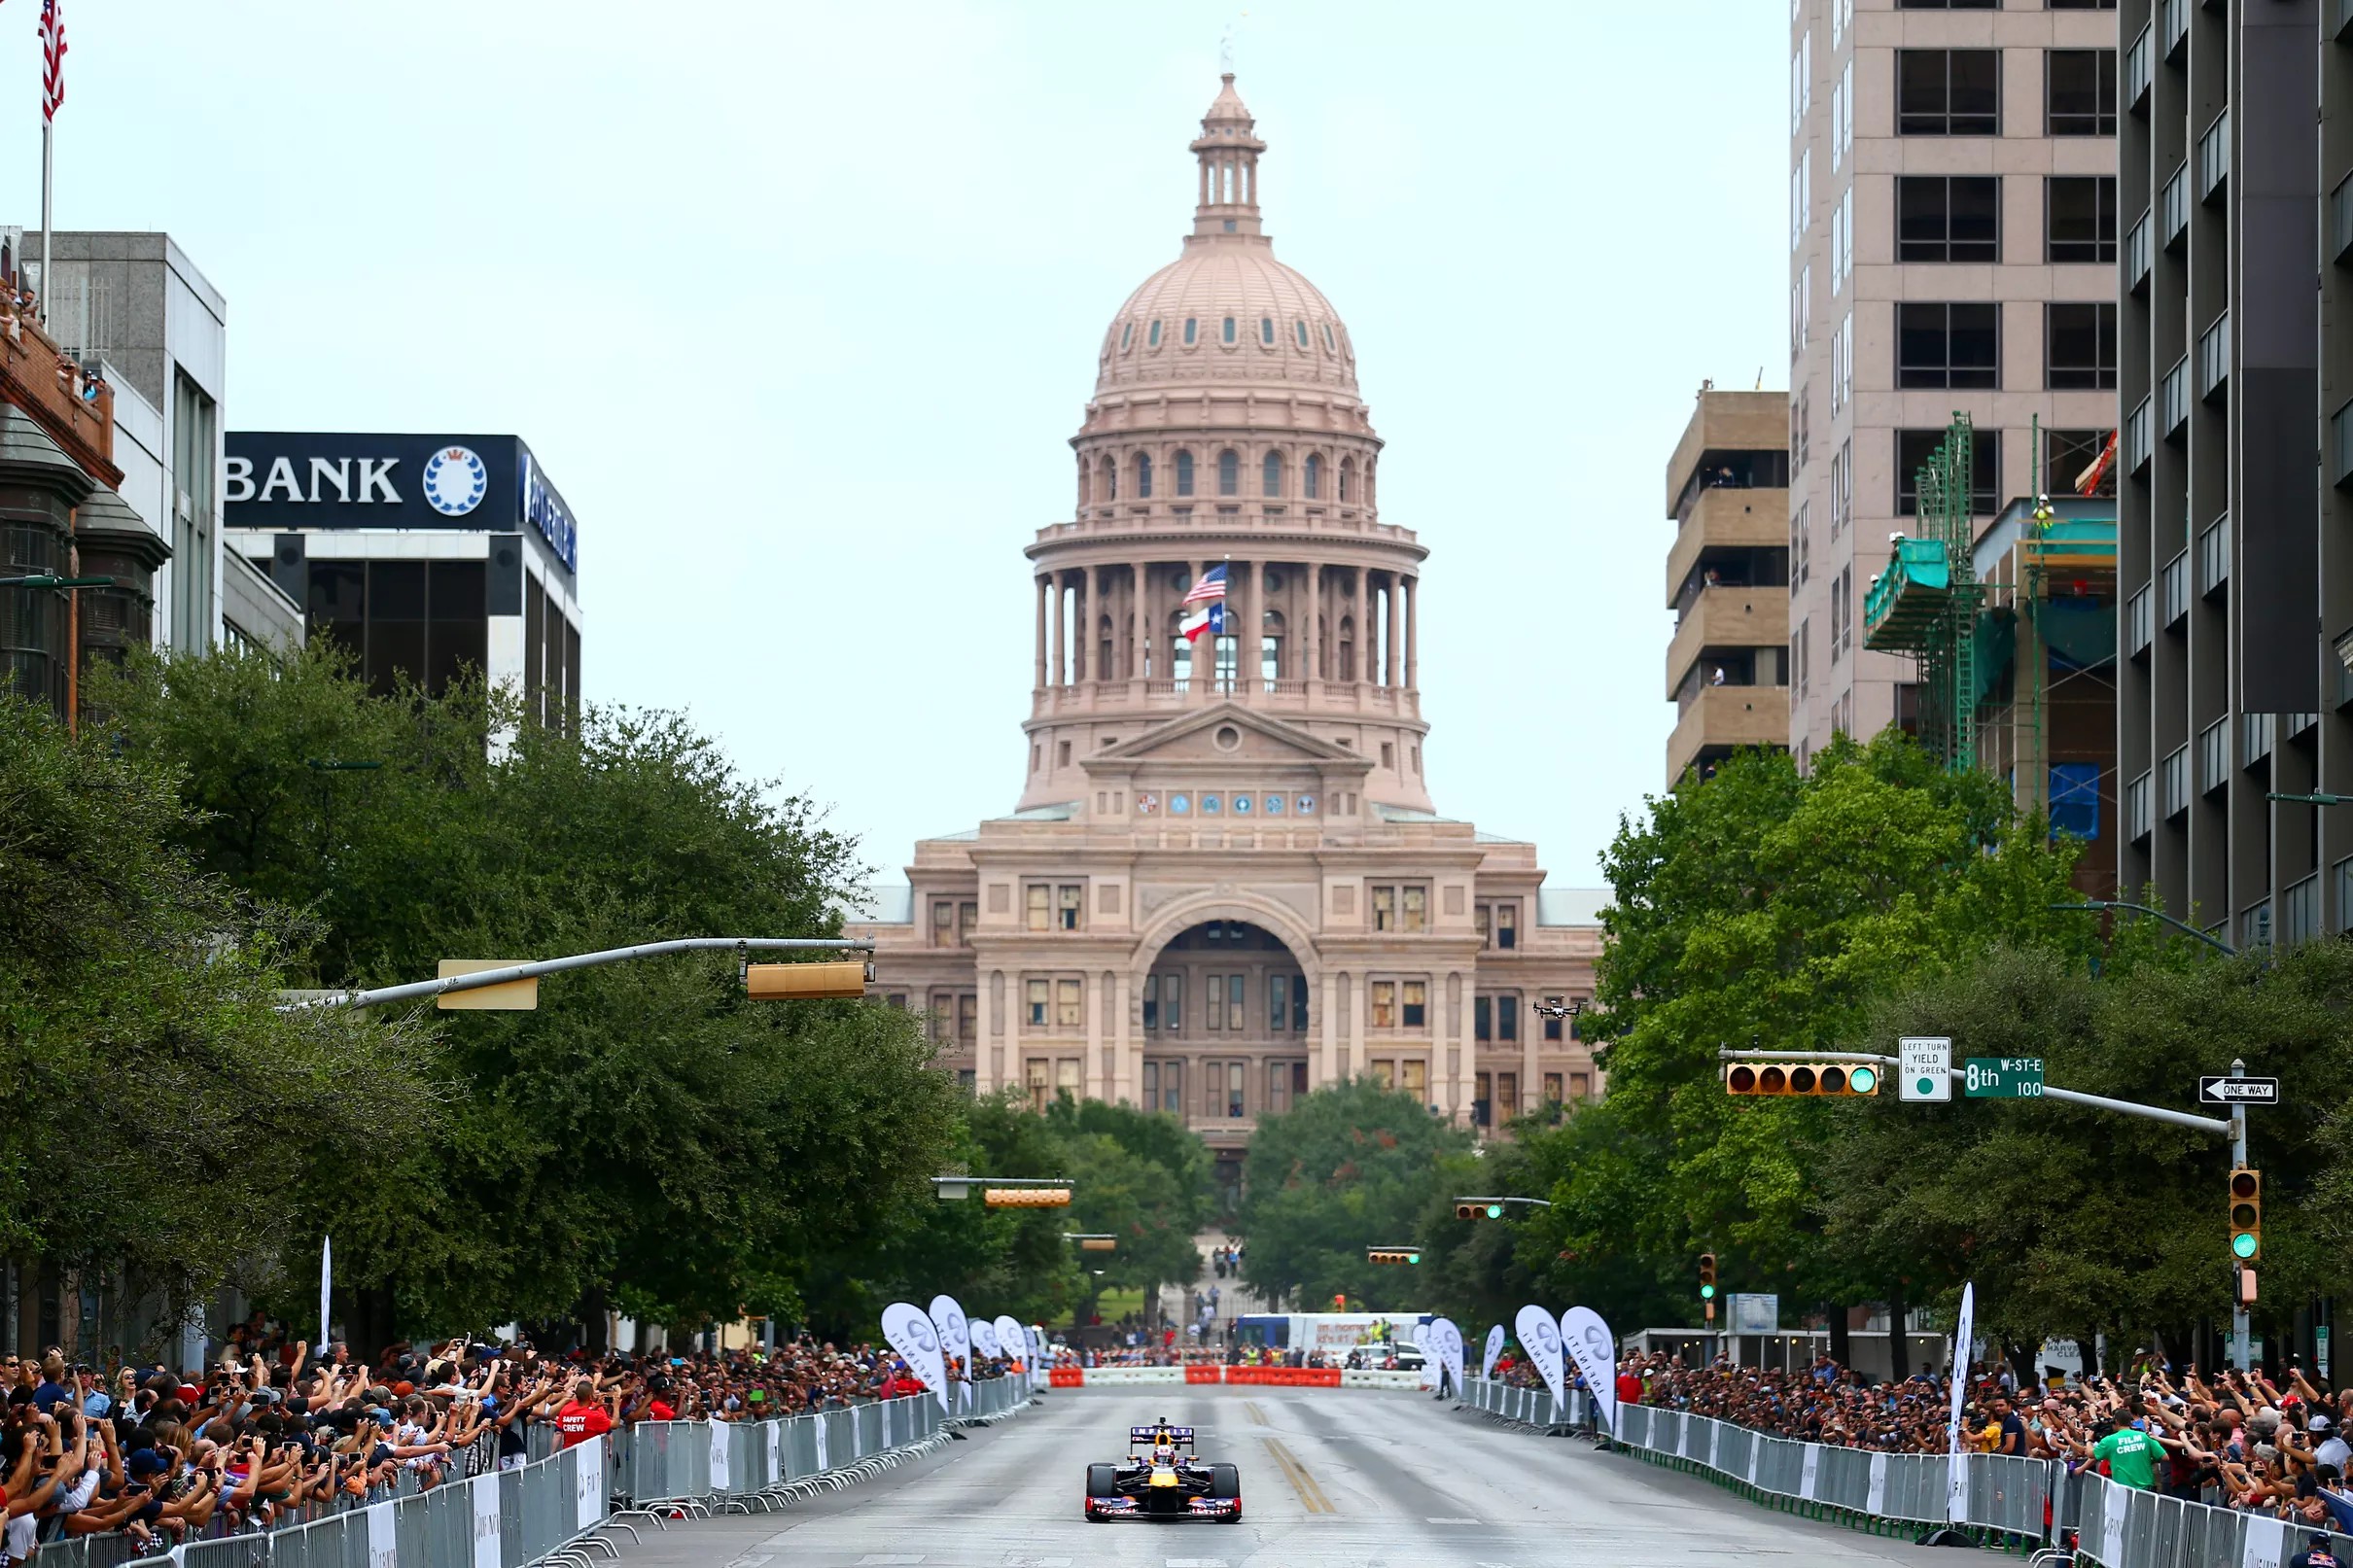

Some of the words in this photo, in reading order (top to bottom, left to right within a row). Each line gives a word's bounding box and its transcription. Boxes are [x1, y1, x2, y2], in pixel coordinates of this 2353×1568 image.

[224, 456, 403, 503] BANK
[1912, 1054, 1939, 1063] YIELD
[1966, 1063, 1999, 1092] 8th
[2017, 1082, 2042, 1097] 100
[2223, 1085, 2243, 1095] ONE
[2248, 1086, 2269, 1096] WAY
[563, 1423, 584, 1432] CREW
[2118, 1434, 2143, 1446] FILM
[2116, 1443, 2146, 1454] CREW
